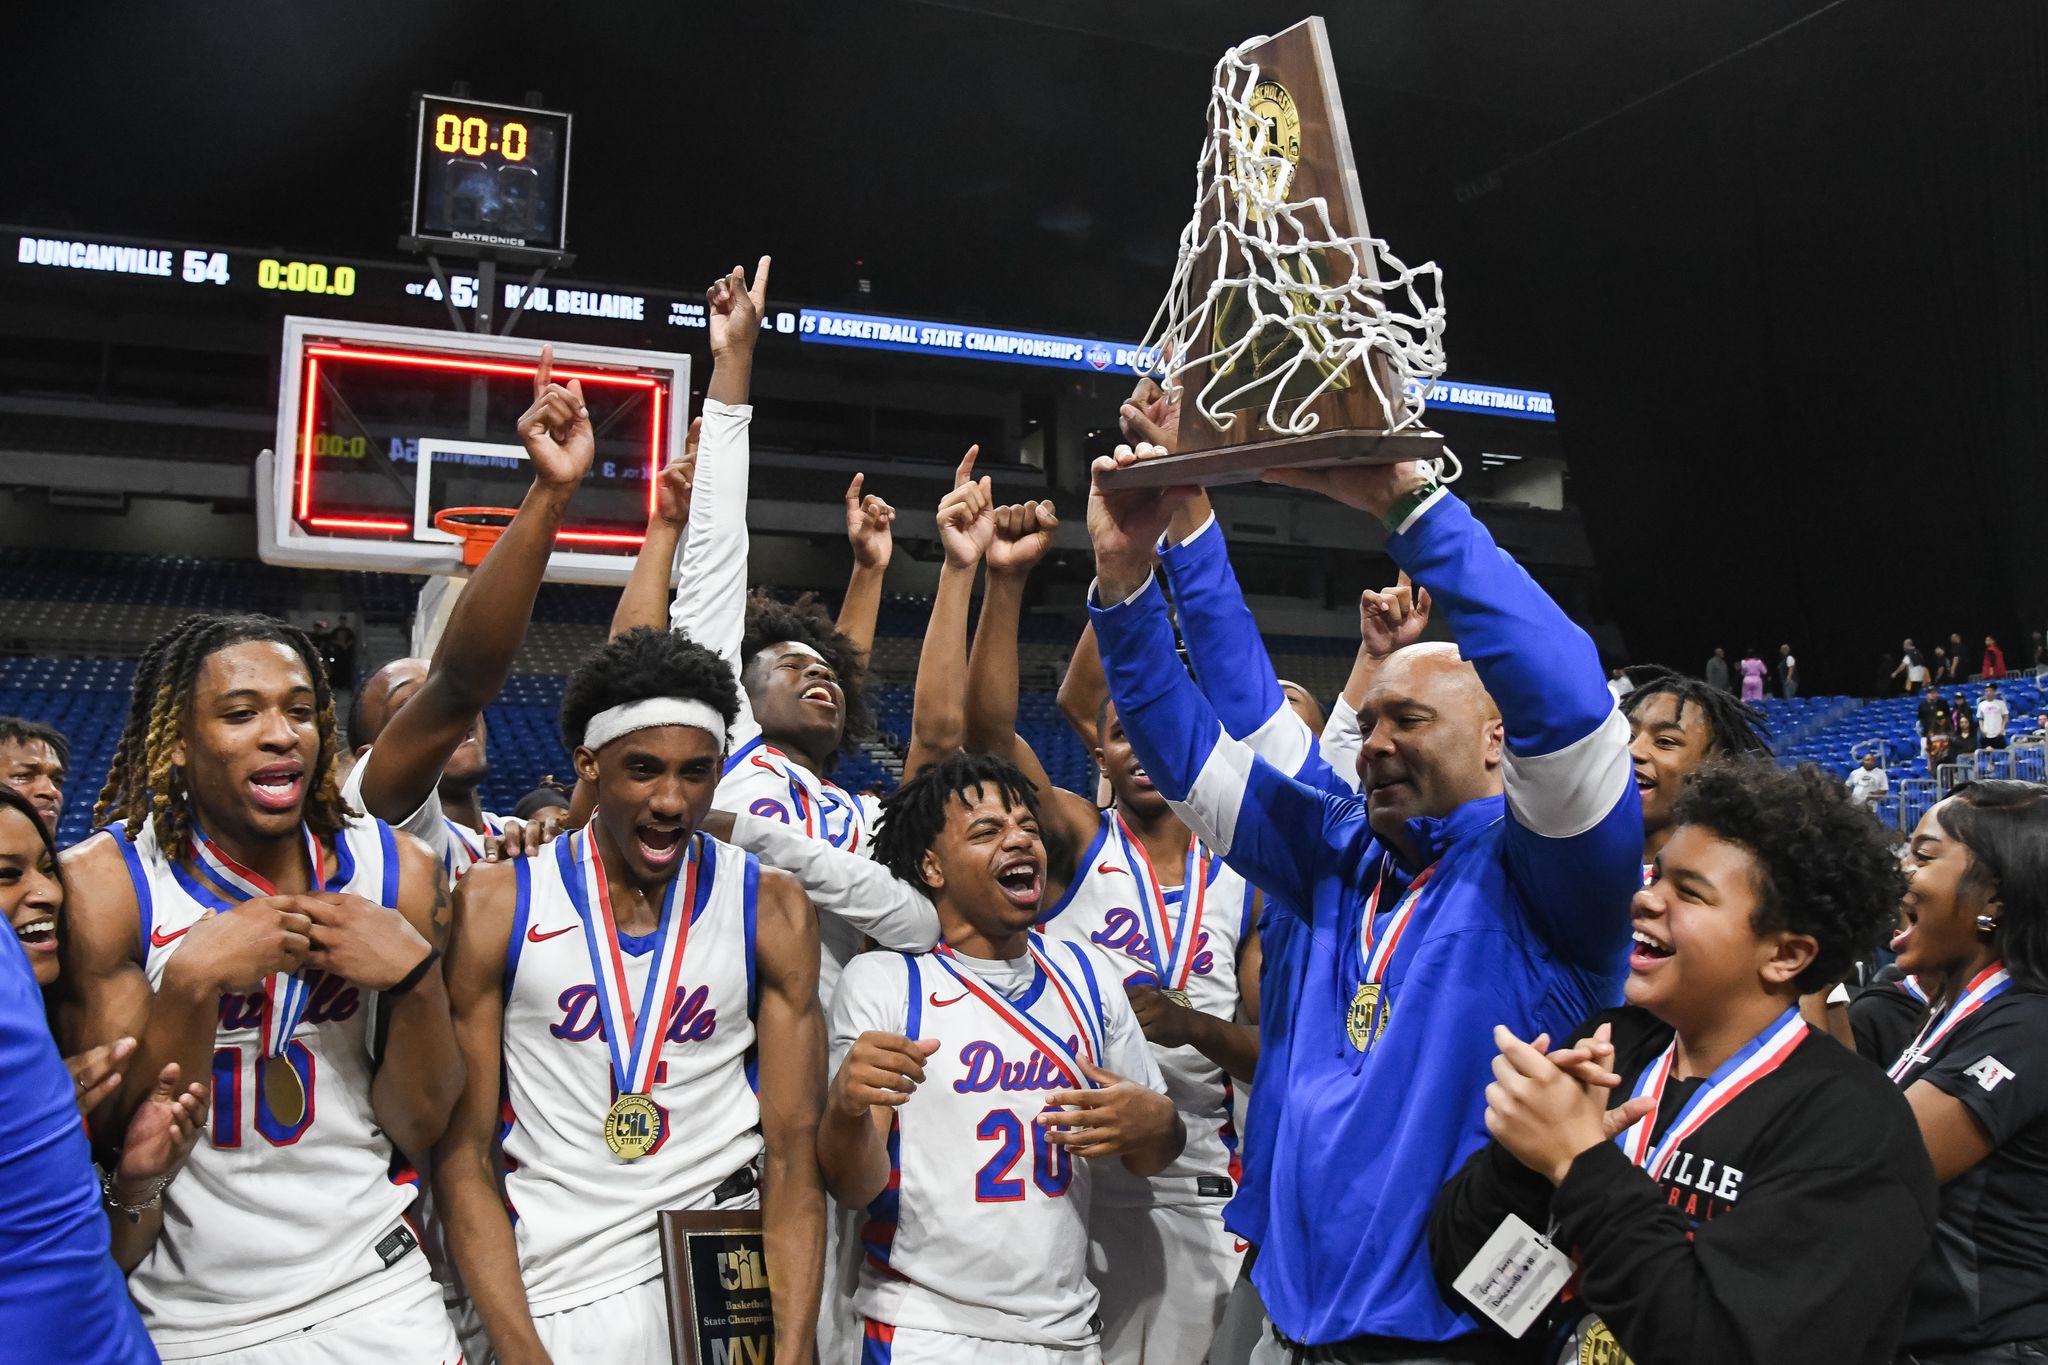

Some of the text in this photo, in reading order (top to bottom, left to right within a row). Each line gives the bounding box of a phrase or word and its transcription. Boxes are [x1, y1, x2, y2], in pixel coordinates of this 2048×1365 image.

[434, 113, 529, 162] 00.0
[452, 231, 526, 247] DAKTRONICS
[18, 237, 230, 285] DUNCANVILLE 54
[258, 258, 356, 297] 0:00.0
[424, 278, 444, 301] 4
[555, 289, 645, 321] BELLAIRE
[671, 303, 704, 316] TEAM
[668, 315, 707, 329] FOULS
[818, 316, 918, 345] BASKETBALL
[920, 327, 963, 348] STATE
[965, 332, 1083, 361] CHAMPIONSHIPS
[1115, 349, 1155, 369] BOYS
[1450, 387, 1525, 411] BASKETBALL
[212, 1038, 315, 1149] 10
[616, 1109, 650, 1137] UIL
[620, 1137, 643, 1145] STATE
[975, 1105, 1074, 1203] 20
[1645, 1146, 1744, 1202] ILLE
[716, 1243, 770, 1291] UIL
[703, 1316, 727, 1326] State
